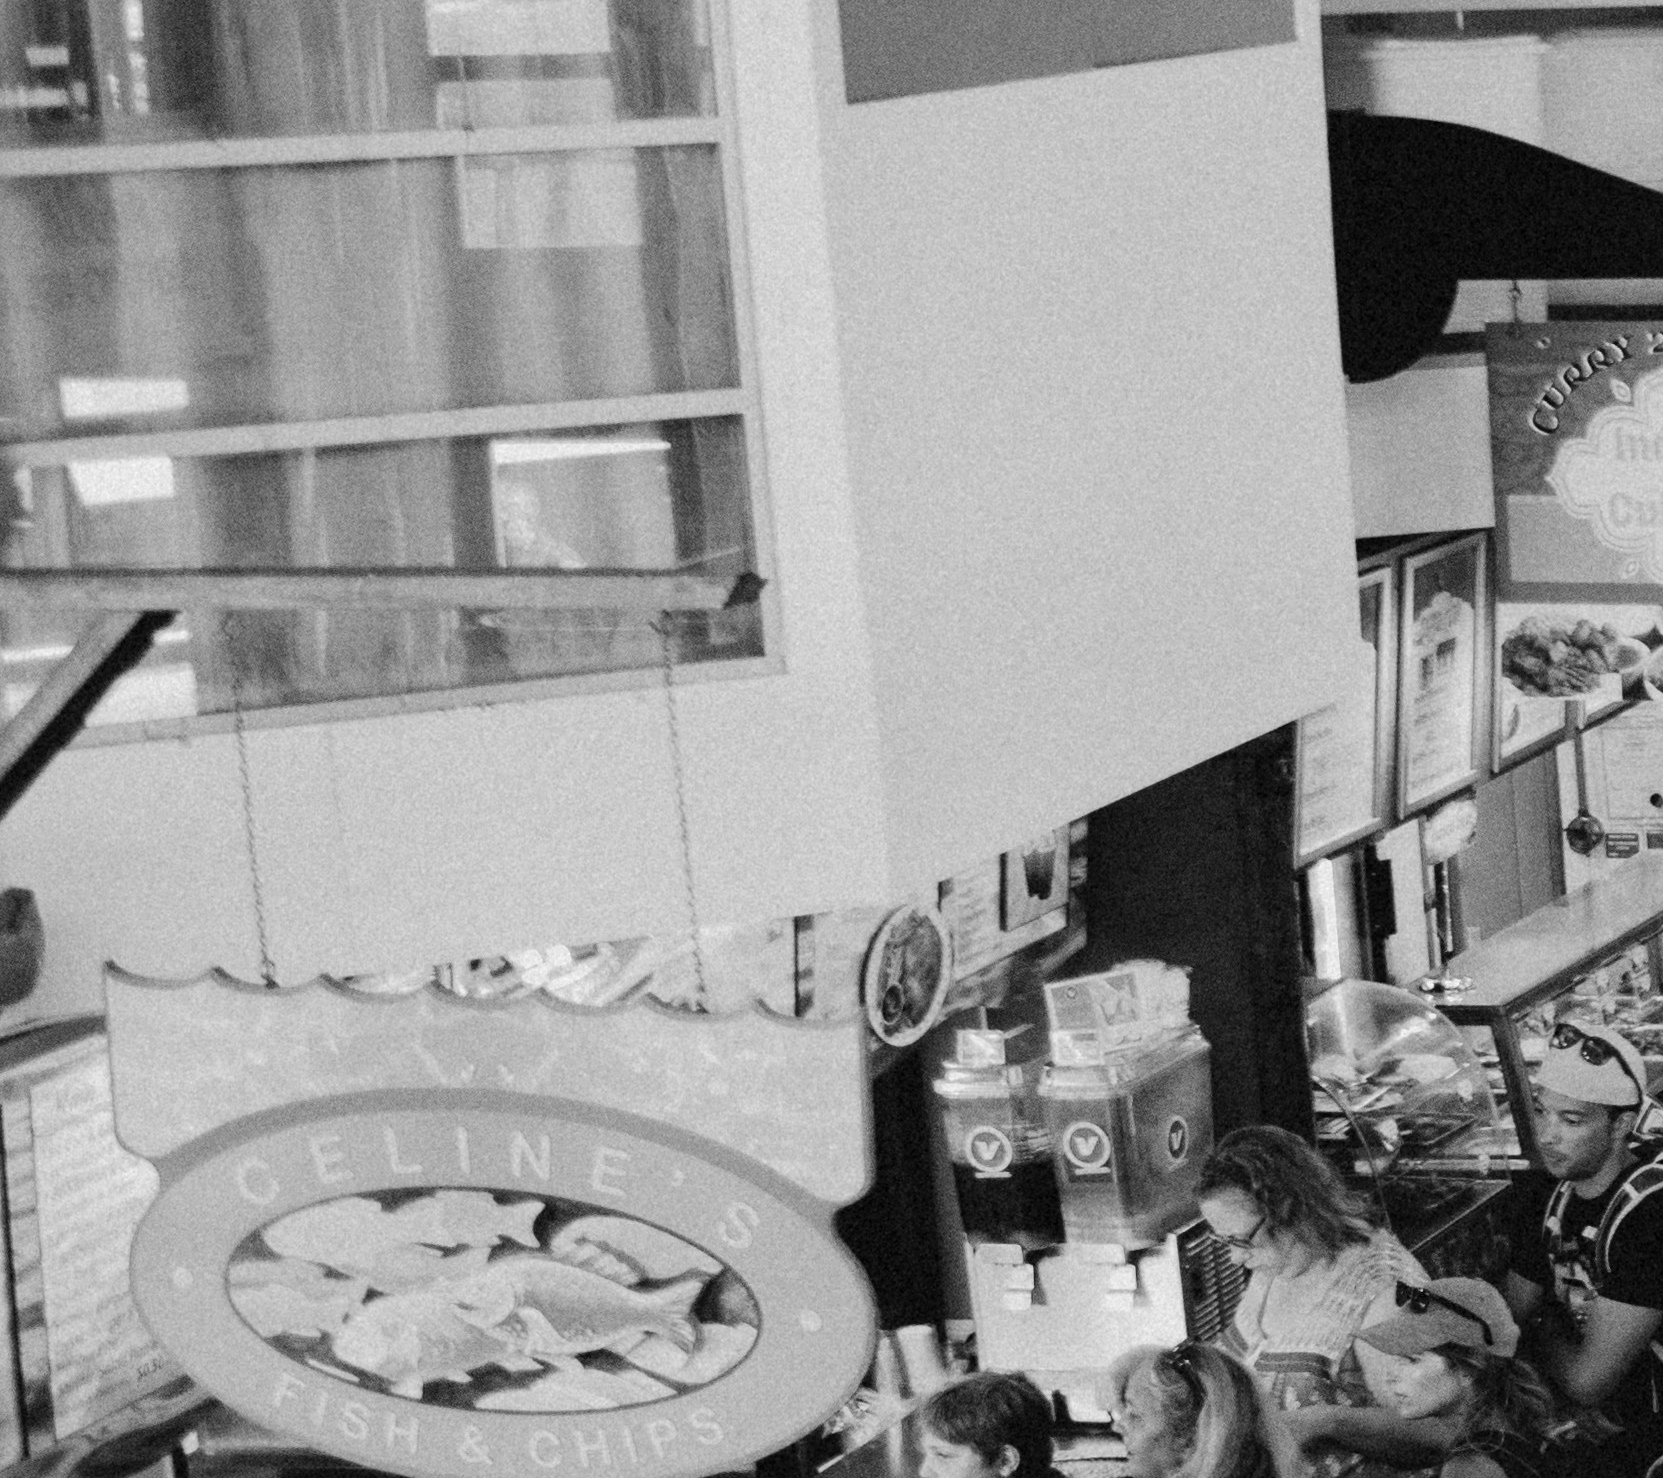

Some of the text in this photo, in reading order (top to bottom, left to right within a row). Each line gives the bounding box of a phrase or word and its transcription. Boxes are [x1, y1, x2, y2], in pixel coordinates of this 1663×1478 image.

[1530, 333, 1633, 436] CURRY
[235, 1126, 760, 1251] CELINE'S
[271, 1377, 726, 1468] FISH & CHIPS
